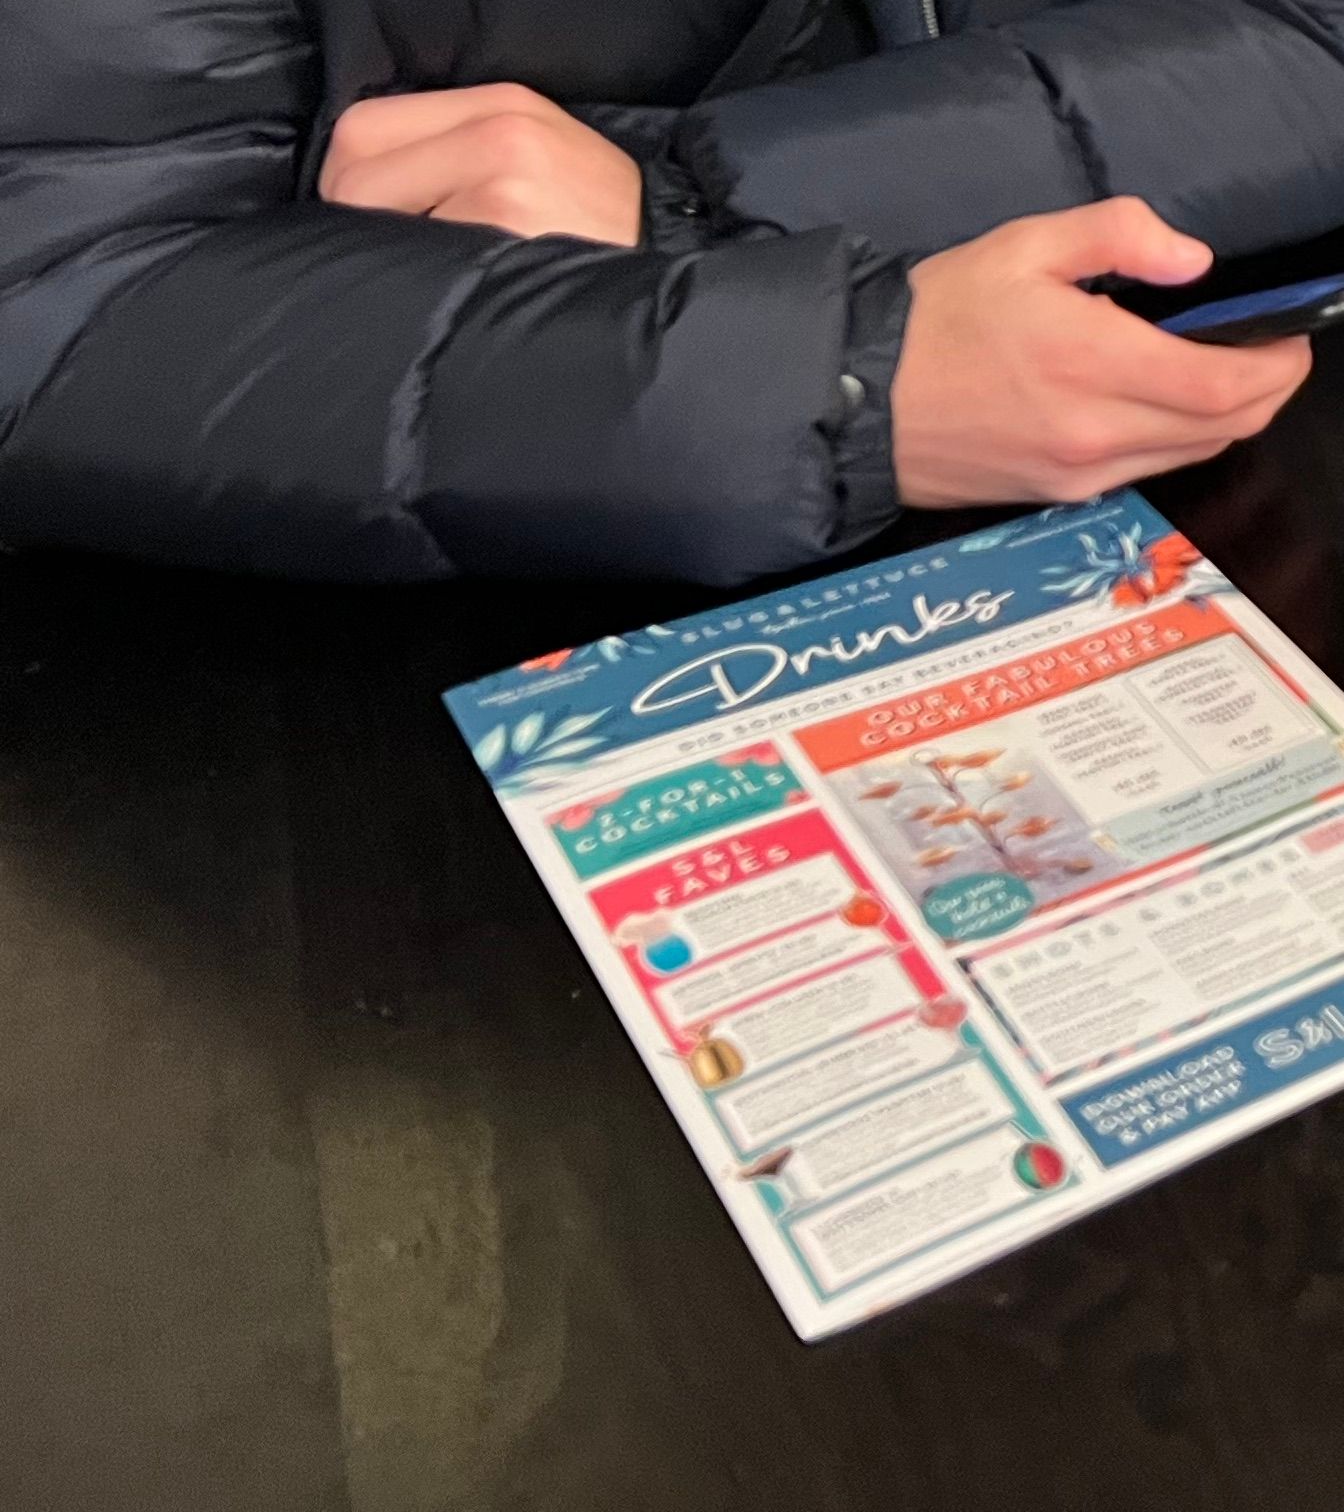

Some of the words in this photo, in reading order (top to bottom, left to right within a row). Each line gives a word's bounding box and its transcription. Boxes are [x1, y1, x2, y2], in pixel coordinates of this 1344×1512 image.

[629, 587, 1016, 718] Drinks
[861, 678, 1061, 746] COCKTAIL
[1069, 627, 1185, 677] TREES
[867, 692, 948, 727] OUR
[961, 620, 1157, 696] FABULOUS
[574, 770, 786, 854] COCKTAILS
[671, 840, 755, 877] S&L
[654, 845, 791, 905] FAVES
